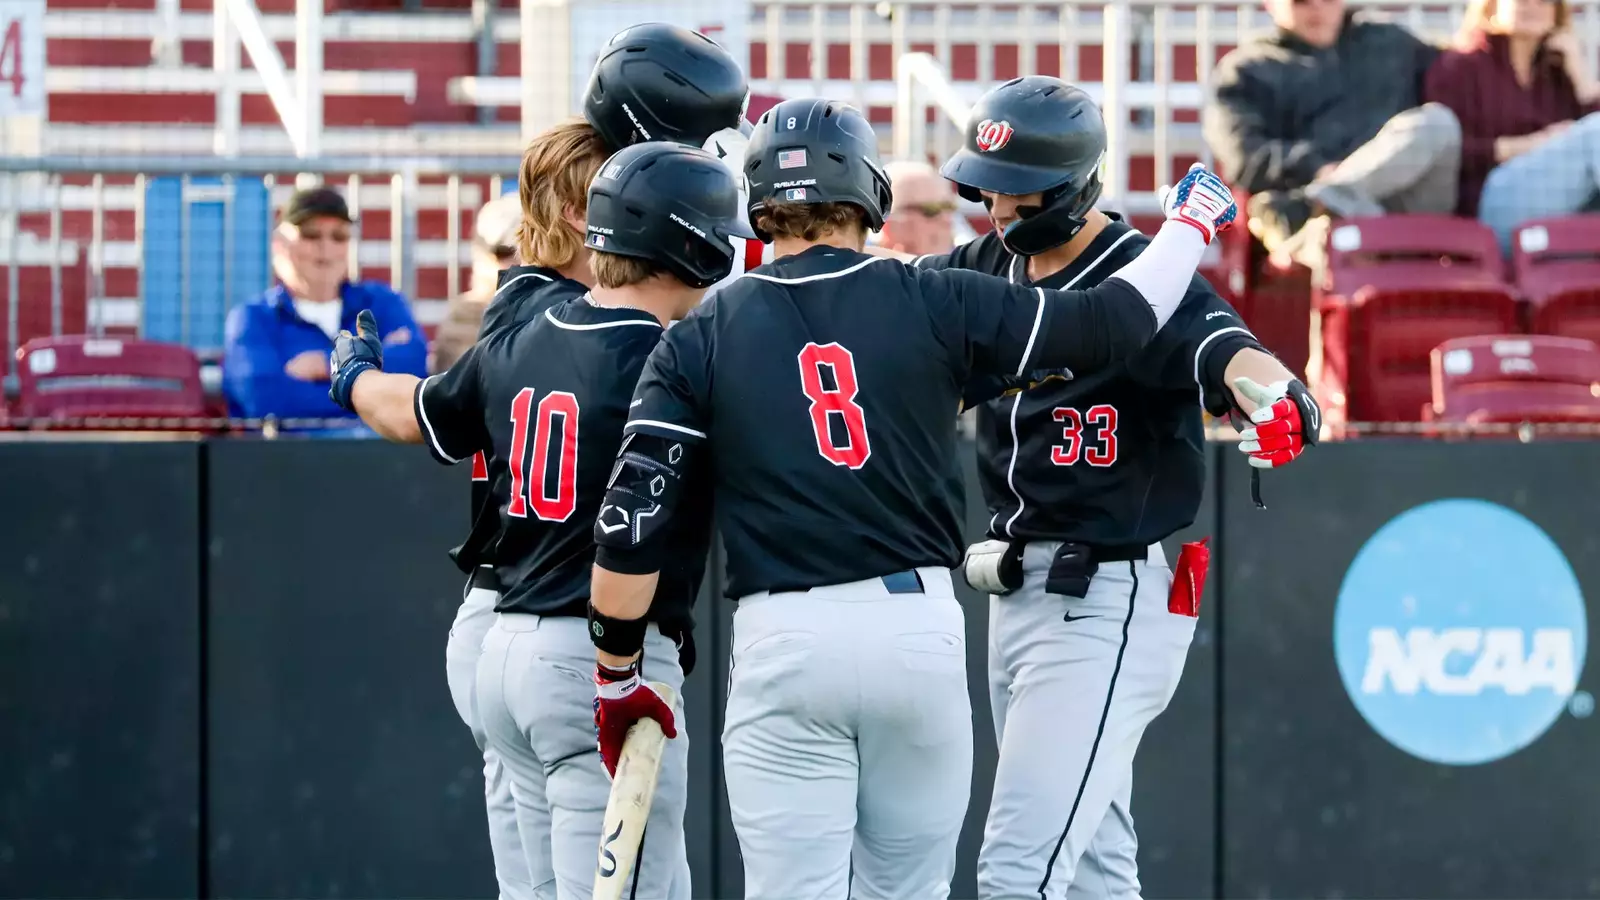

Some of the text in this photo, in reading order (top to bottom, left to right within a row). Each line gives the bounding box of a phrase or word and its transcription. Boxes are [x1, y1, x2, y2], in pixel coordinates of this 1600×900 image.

[787, 117, 796, 129] 8
[669, 213, 706, 239] RAWLINGS
[797, 341, 871, 470] 8
[1050, 404, 1118, 467] 33
[507, 387, 580, 523] 10
[1361, 628, 1574, 695] NCAA
